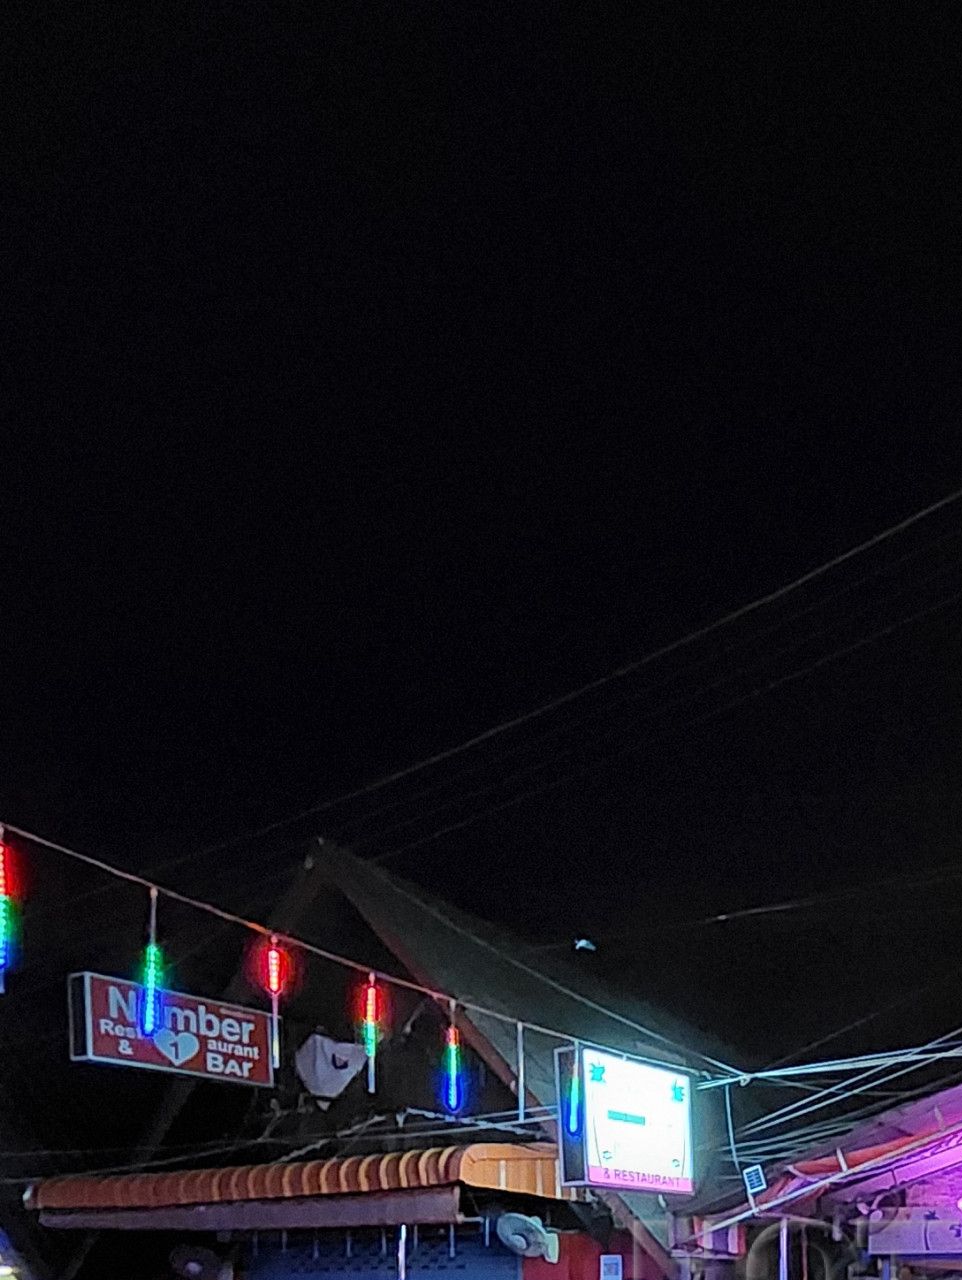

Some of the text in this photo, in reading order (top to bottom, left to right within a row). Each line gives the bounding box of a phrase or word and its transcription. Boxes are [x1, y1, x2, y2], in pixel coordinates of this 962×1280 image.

[108, 985, 255, 1044] Nmber
[118, 1039, 133, 1055] &
[169, 1040, 180, 1060] 1
[207, 1039, 259, 1060] aurant
[614, 1169, 680, 1188] RESTAURANT
